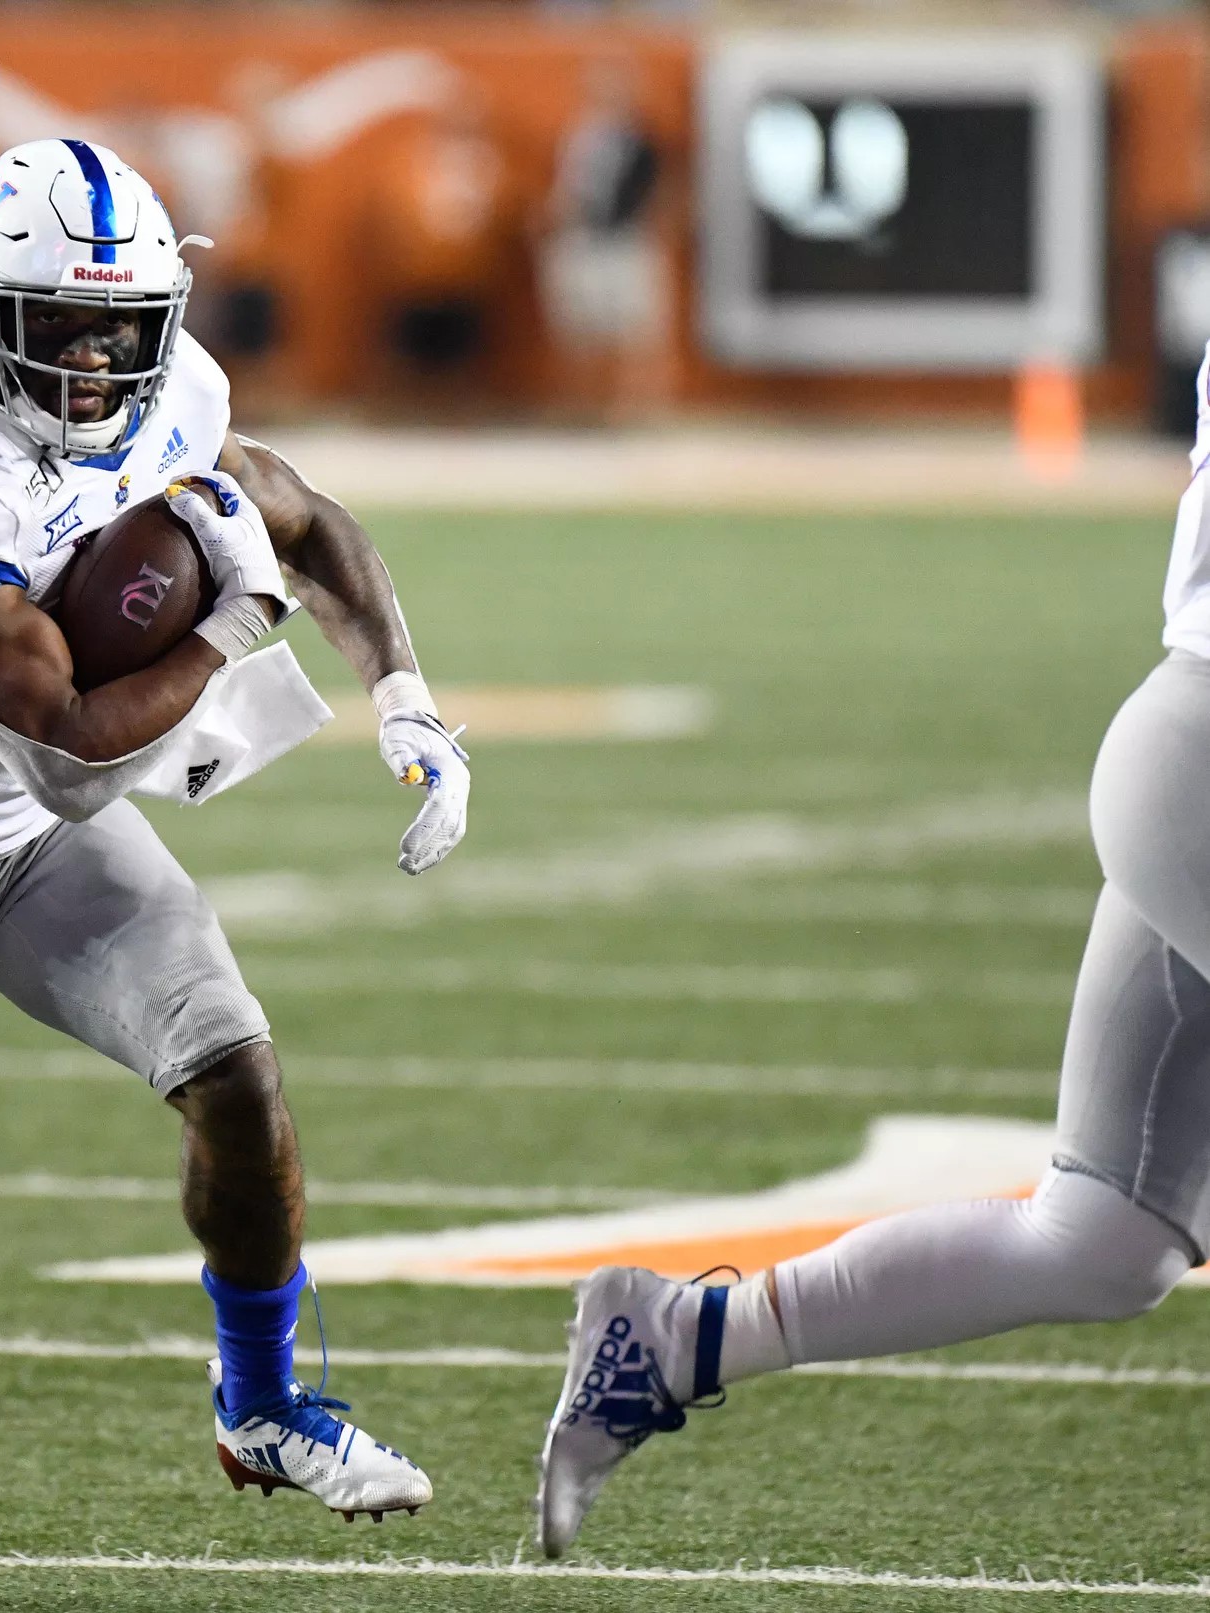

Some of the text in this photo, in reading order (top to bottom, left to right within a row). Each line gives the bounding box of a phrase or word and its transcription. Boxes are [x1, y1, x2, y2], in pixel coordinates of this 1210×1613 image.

[73, 267, 133, 283] Riddell
[157, 443, 189, 474] adidas
[120, 562, 175, 632] KU
[188, 758, 220, 799] adidas
[560, 1316, 632, 1427] adidas
